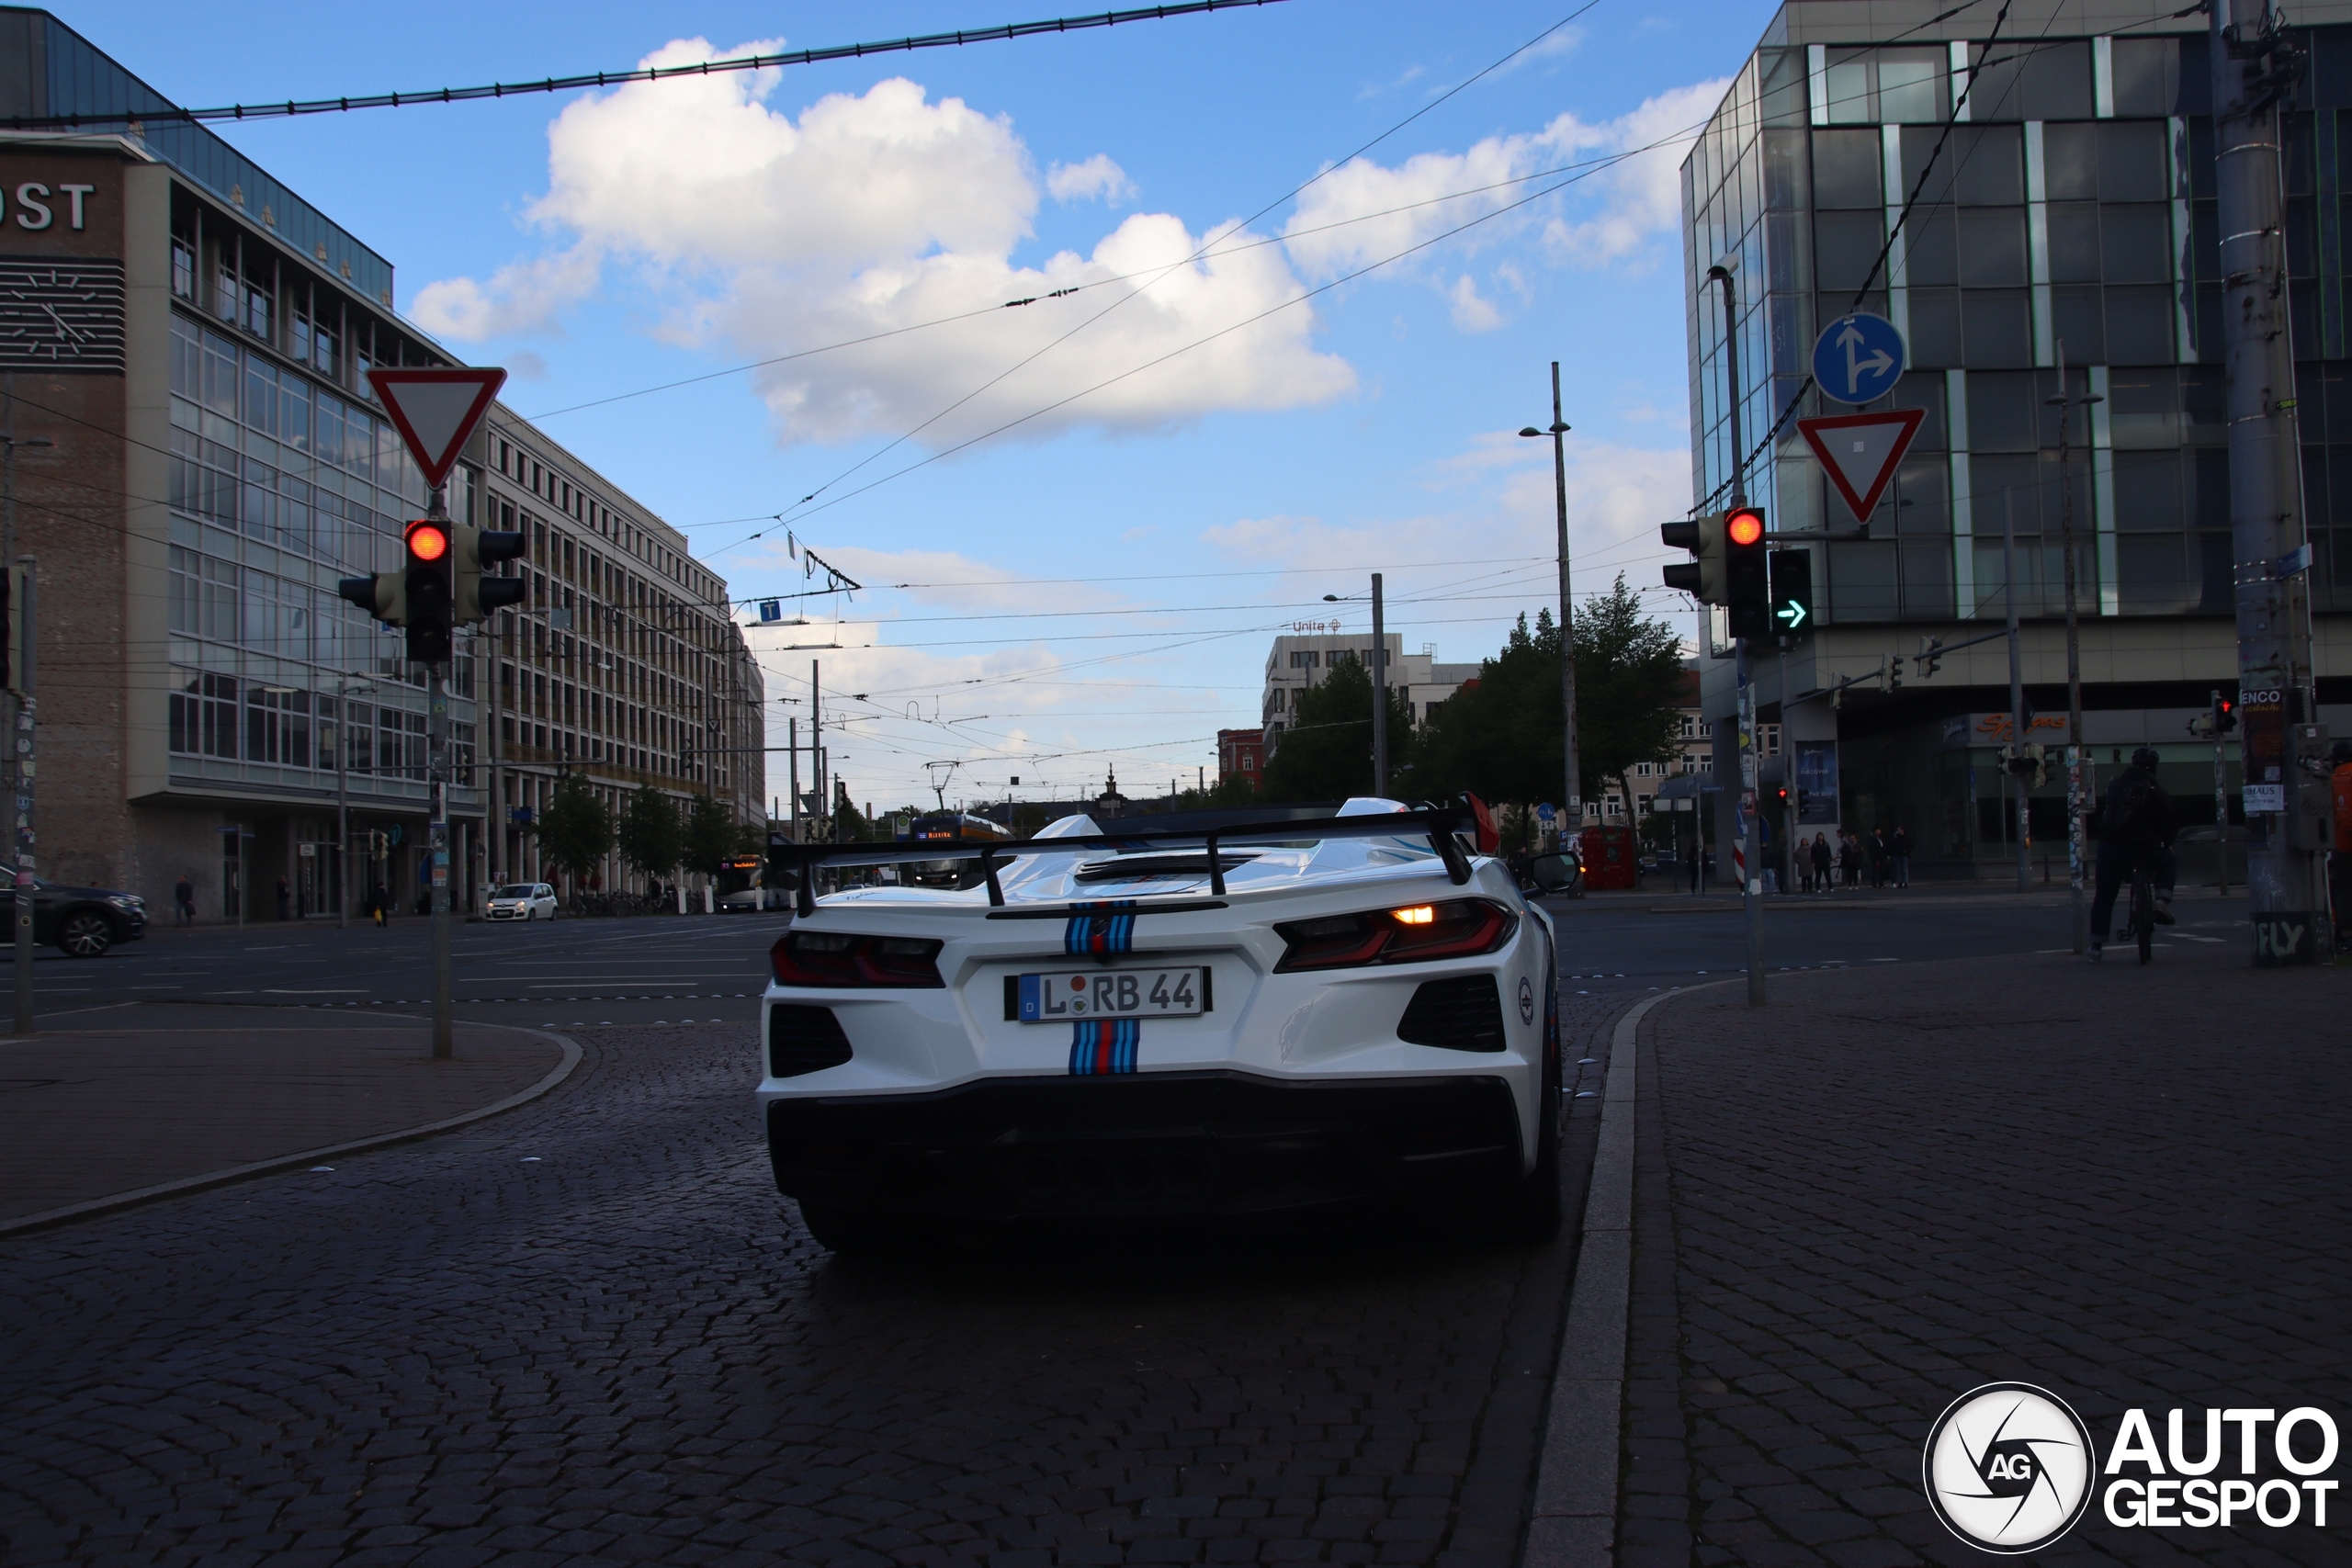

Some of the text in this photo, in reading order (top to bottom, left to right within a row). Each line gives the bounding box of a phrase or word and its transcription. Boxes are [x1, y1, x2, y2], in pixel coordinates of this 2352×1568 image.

[0, 182, 95, 230] ST
[763, 604, 775, 619] T
[1293, 621, 1324, 632] Unite
[1045, 973, 1194, 1014] L RB 44
[1025, 1002, 1035, 1012] D
